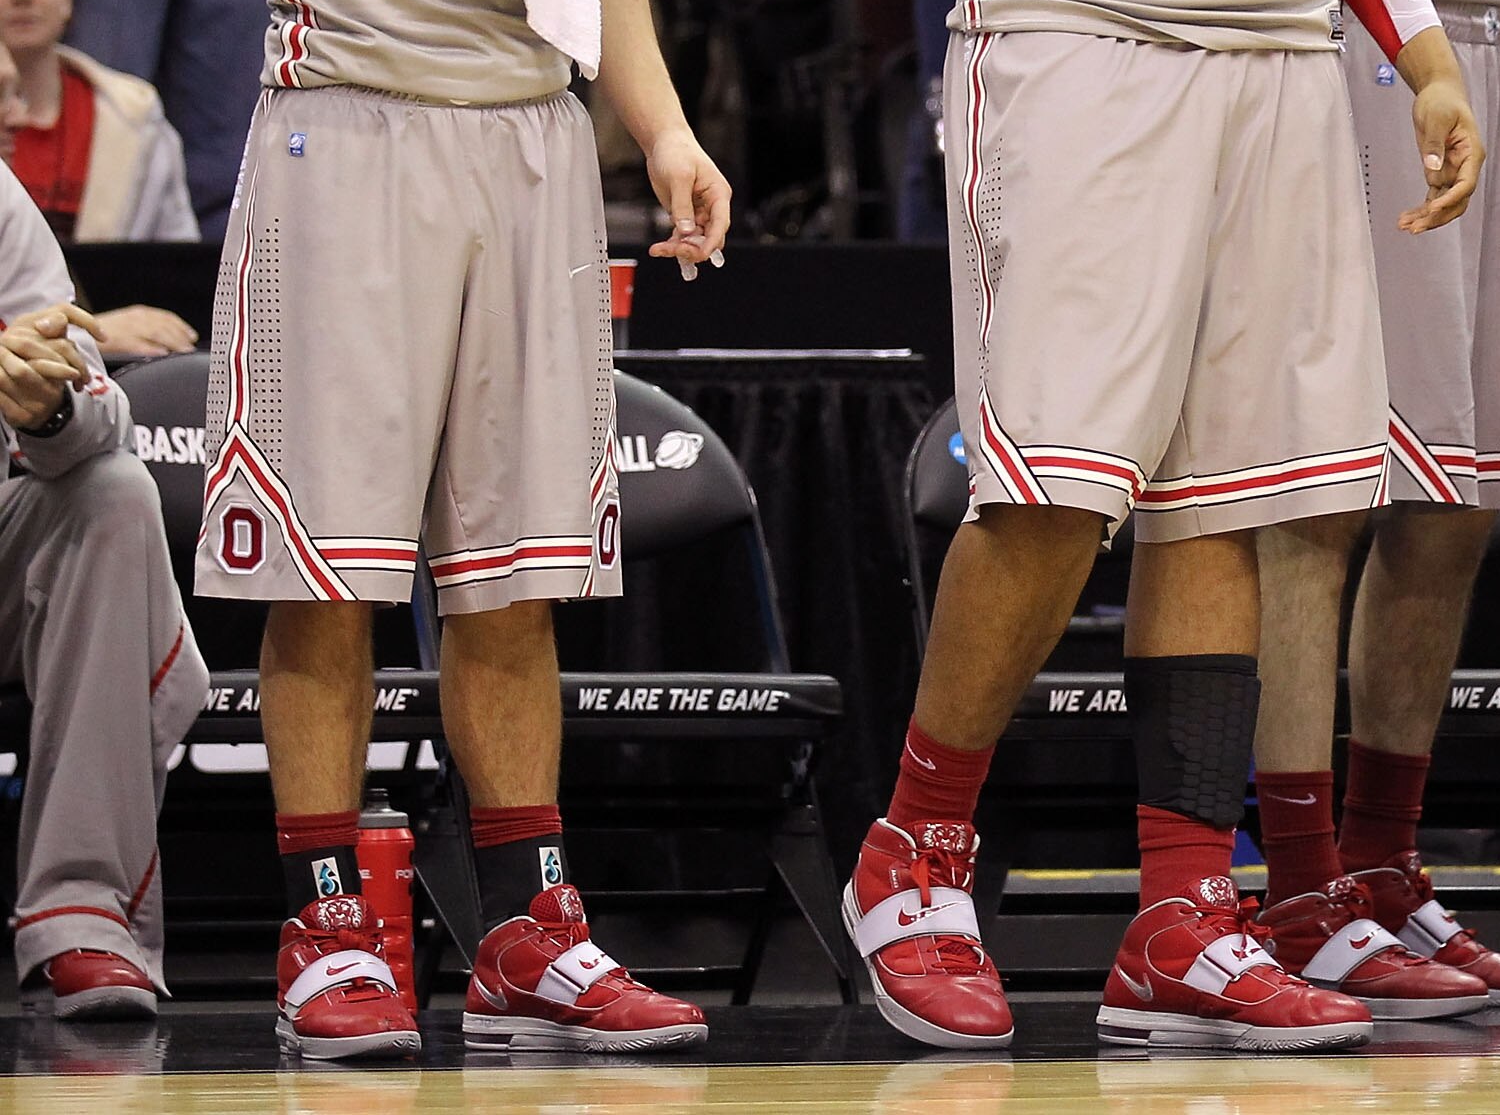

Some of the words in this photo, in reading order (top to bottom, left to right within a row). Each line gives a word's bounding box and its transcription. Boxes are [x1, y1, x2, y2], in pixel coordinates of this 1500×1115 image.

[578, 687, 613, 711] WE
[614, 687, 664, 712] ARE
[668, 687, 714, 712] THE
[717, 688, 784, 713] GAME
[1048, 689, 1084, 712] WE
[1450, 686, 1485, 709] WE
